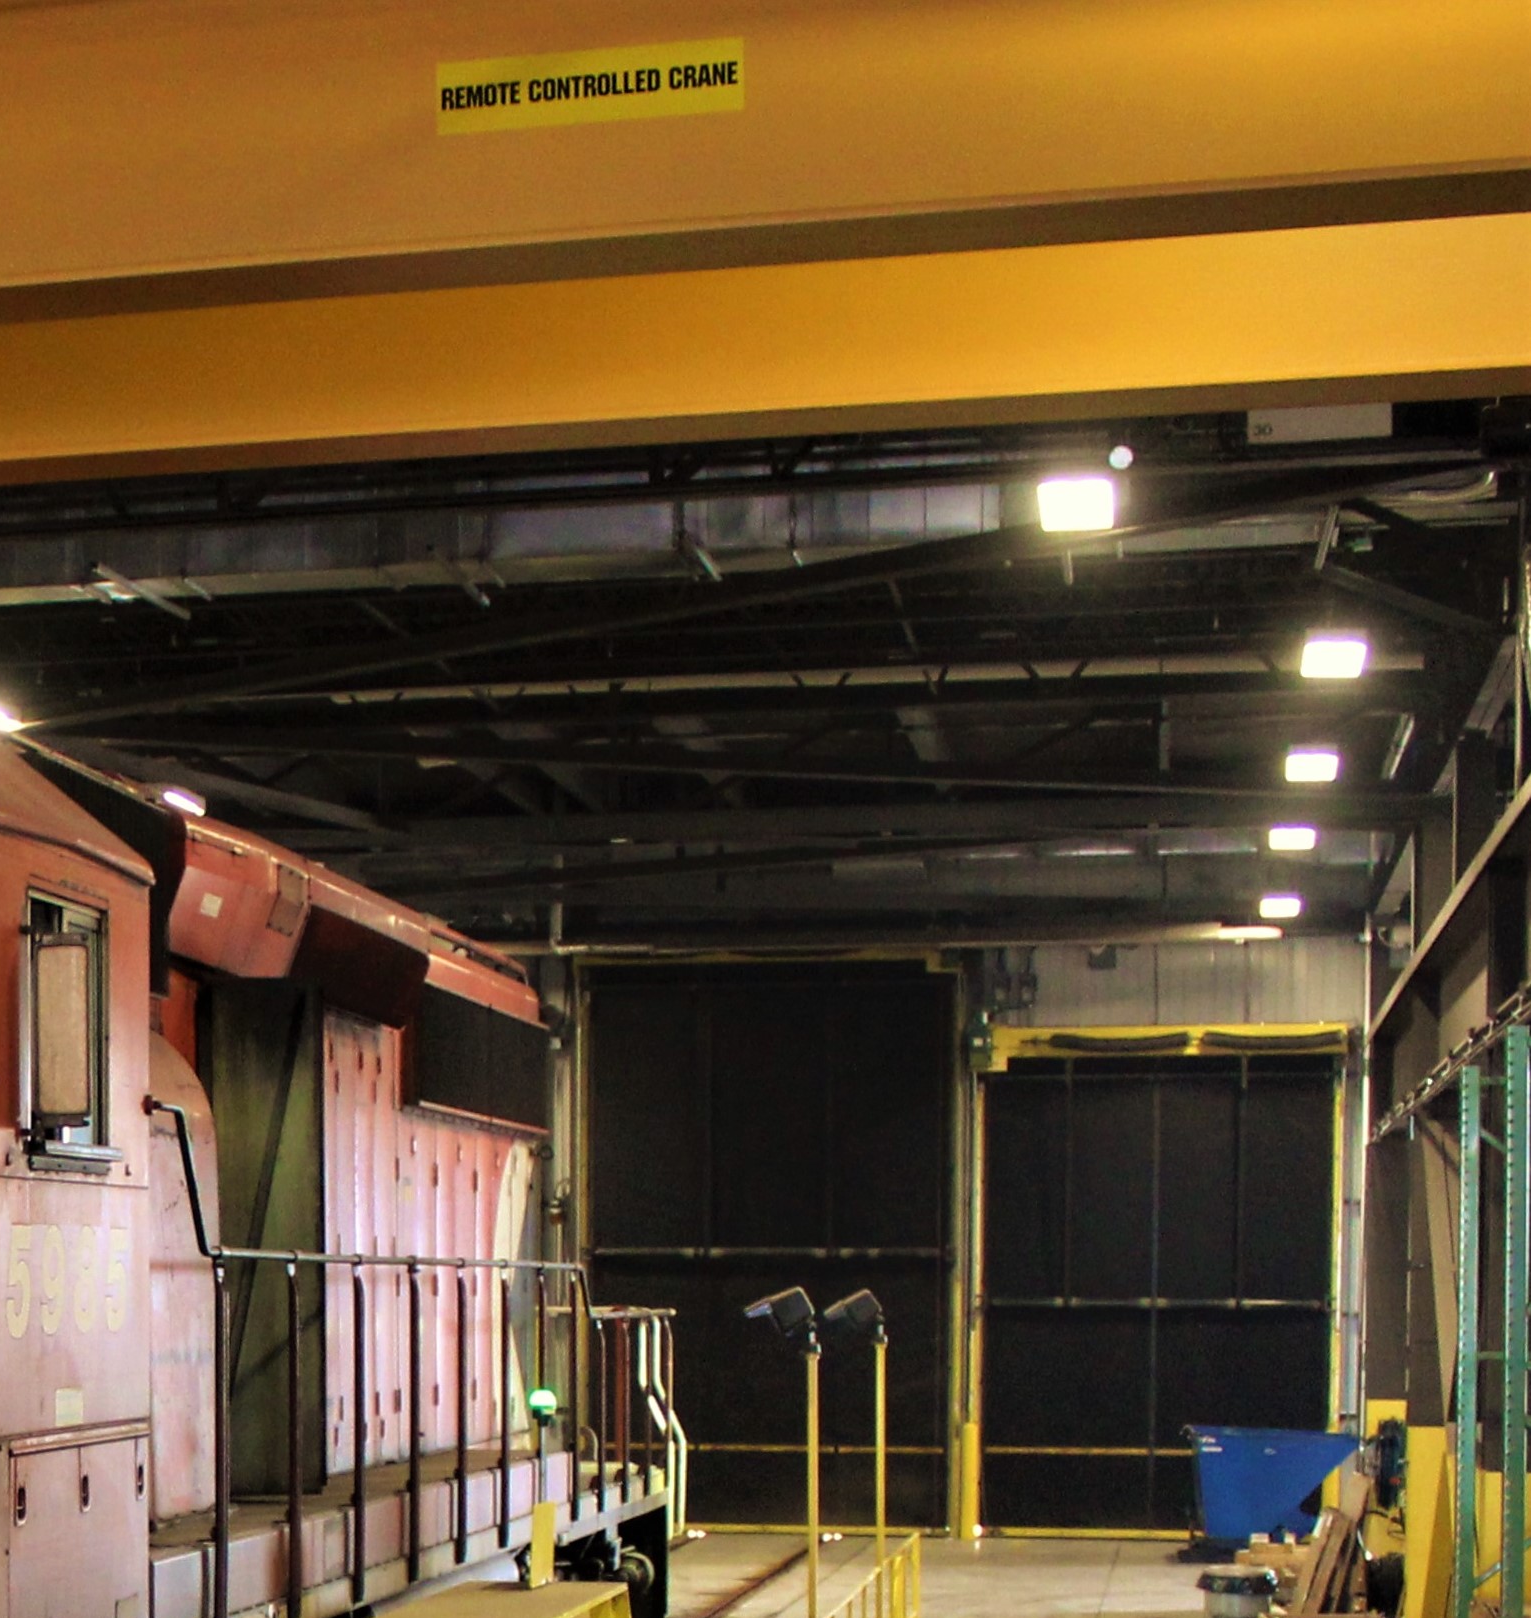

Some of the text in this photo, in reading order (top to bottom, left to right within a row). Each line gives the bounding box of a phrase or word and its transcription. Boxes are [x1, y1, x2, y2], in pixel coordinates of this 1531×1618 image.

[441, 61, 738, 111] REMOTE CONTROLLED CRANE
[5, 1223, 130, 1339] 5985
